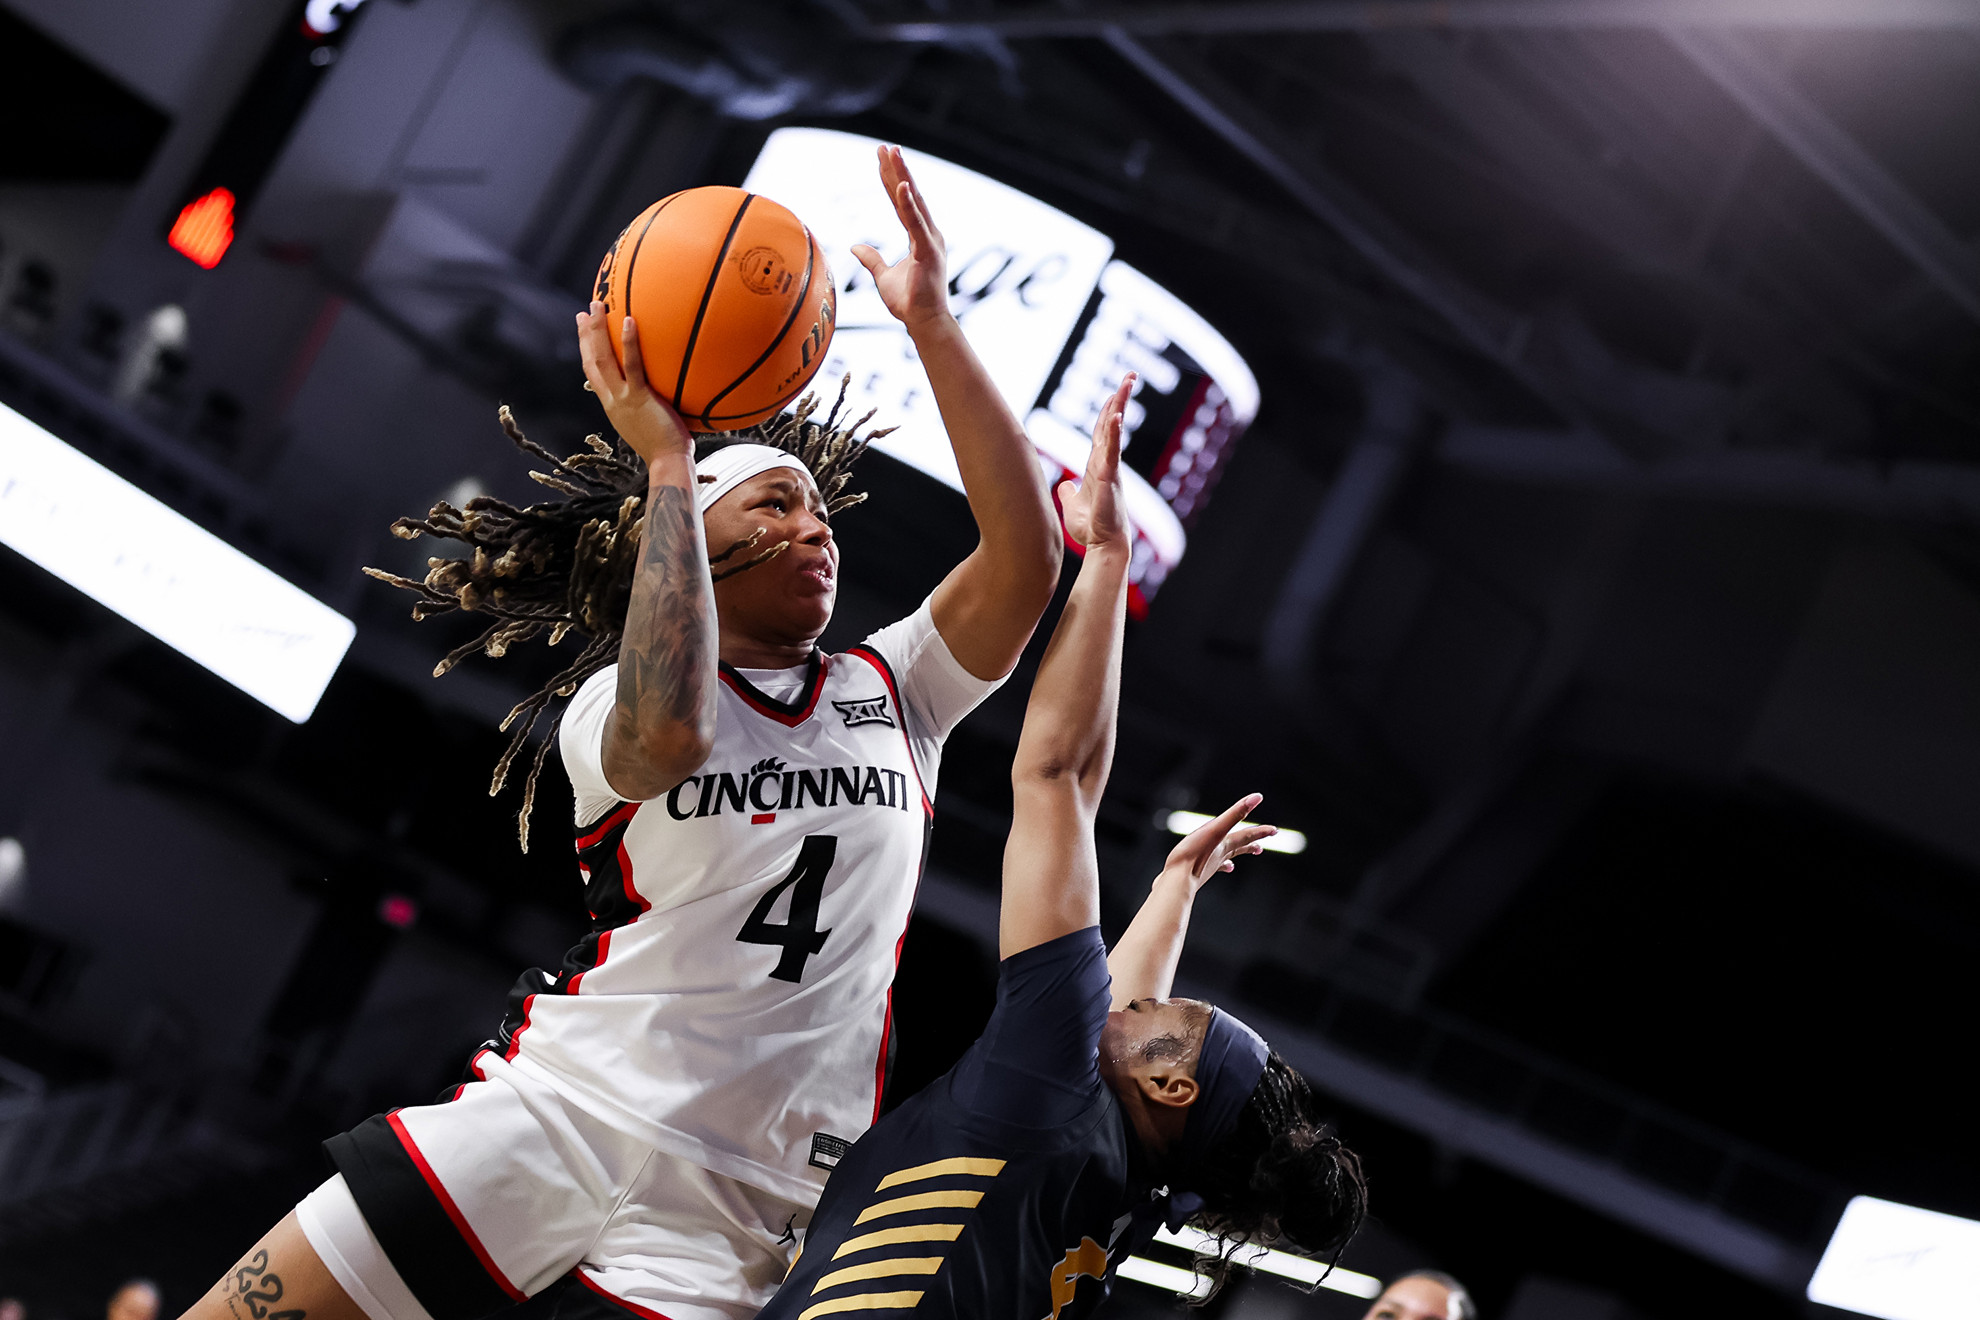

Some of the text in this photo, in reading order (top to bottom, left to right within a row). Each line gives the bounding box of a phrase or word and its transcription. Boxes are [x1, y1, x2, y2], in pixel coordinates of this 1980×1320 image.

[832, 695, 895, 728] XII
[666, 765, 908, 821] CINCINNATI
[736, 834, 838, 984] 4
